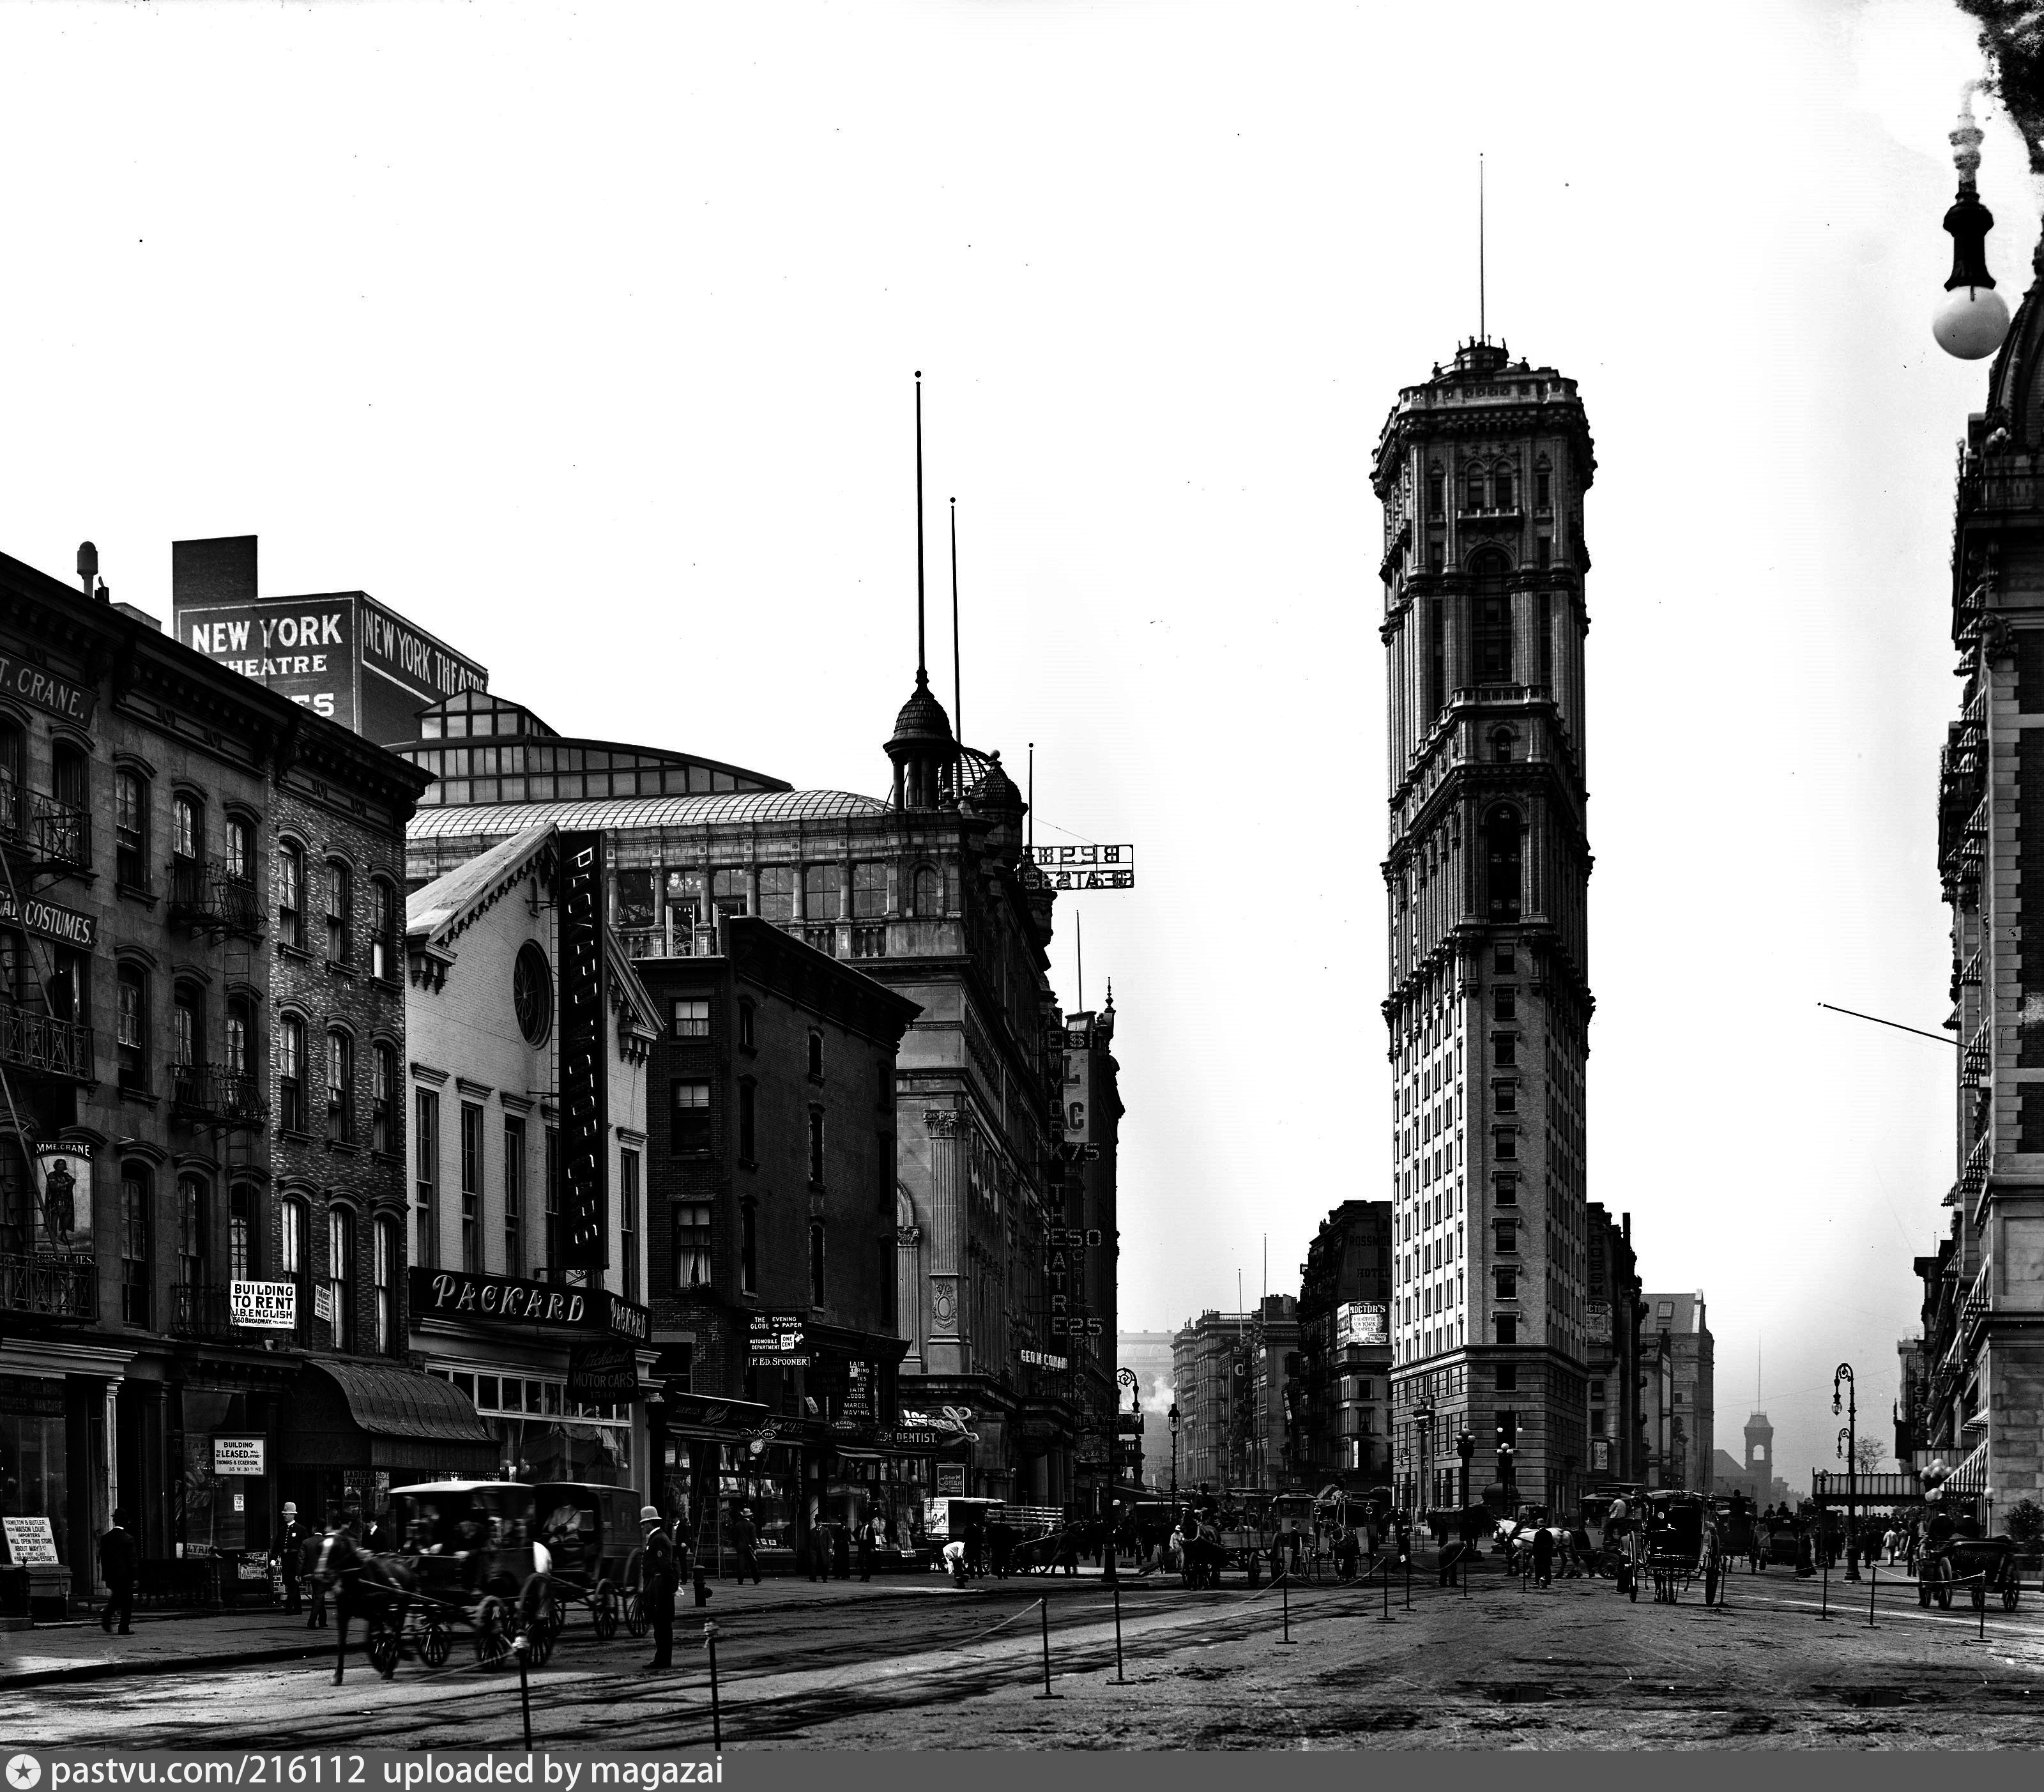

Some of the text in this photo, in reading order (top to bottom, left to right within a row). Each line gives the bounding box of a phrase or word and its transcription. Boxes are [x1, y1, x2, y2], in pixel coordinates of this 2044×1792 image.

[192, 614, 343, 654] NEW YORK
[365, 608, 394, 662] NEW
[396, 627, 431, 684] YORK
[17, 668, 84, 719] CRANE.
[26, 900, 92, 945] COSTUMES.
[1067, 1142, 1100, 1161] 75
[1048, 1007, 1067, 1335] NEW YORK THEATRE
[1067, 1229, 1102, 1247] 50
[37, 1253, 95, 1265] COSUMES.
[1357, 1268, 1391, 1278] HOTEL
[234, 1283, 293, 1297] BUILDING
[432, 1275, 585, 1322] PACKARD
[233, 1295, 293, 1310] TO RENT
[1350, 1304, 1385, 1314] PROCTOR'S
[611, 1296, 646, 1339] PACKARD
[1069, 1317, 1104, 1336] 25
[772, 1358, 808, 1366] SPOONER
[574, 1372, 634, 1388] MOTOR CARS
